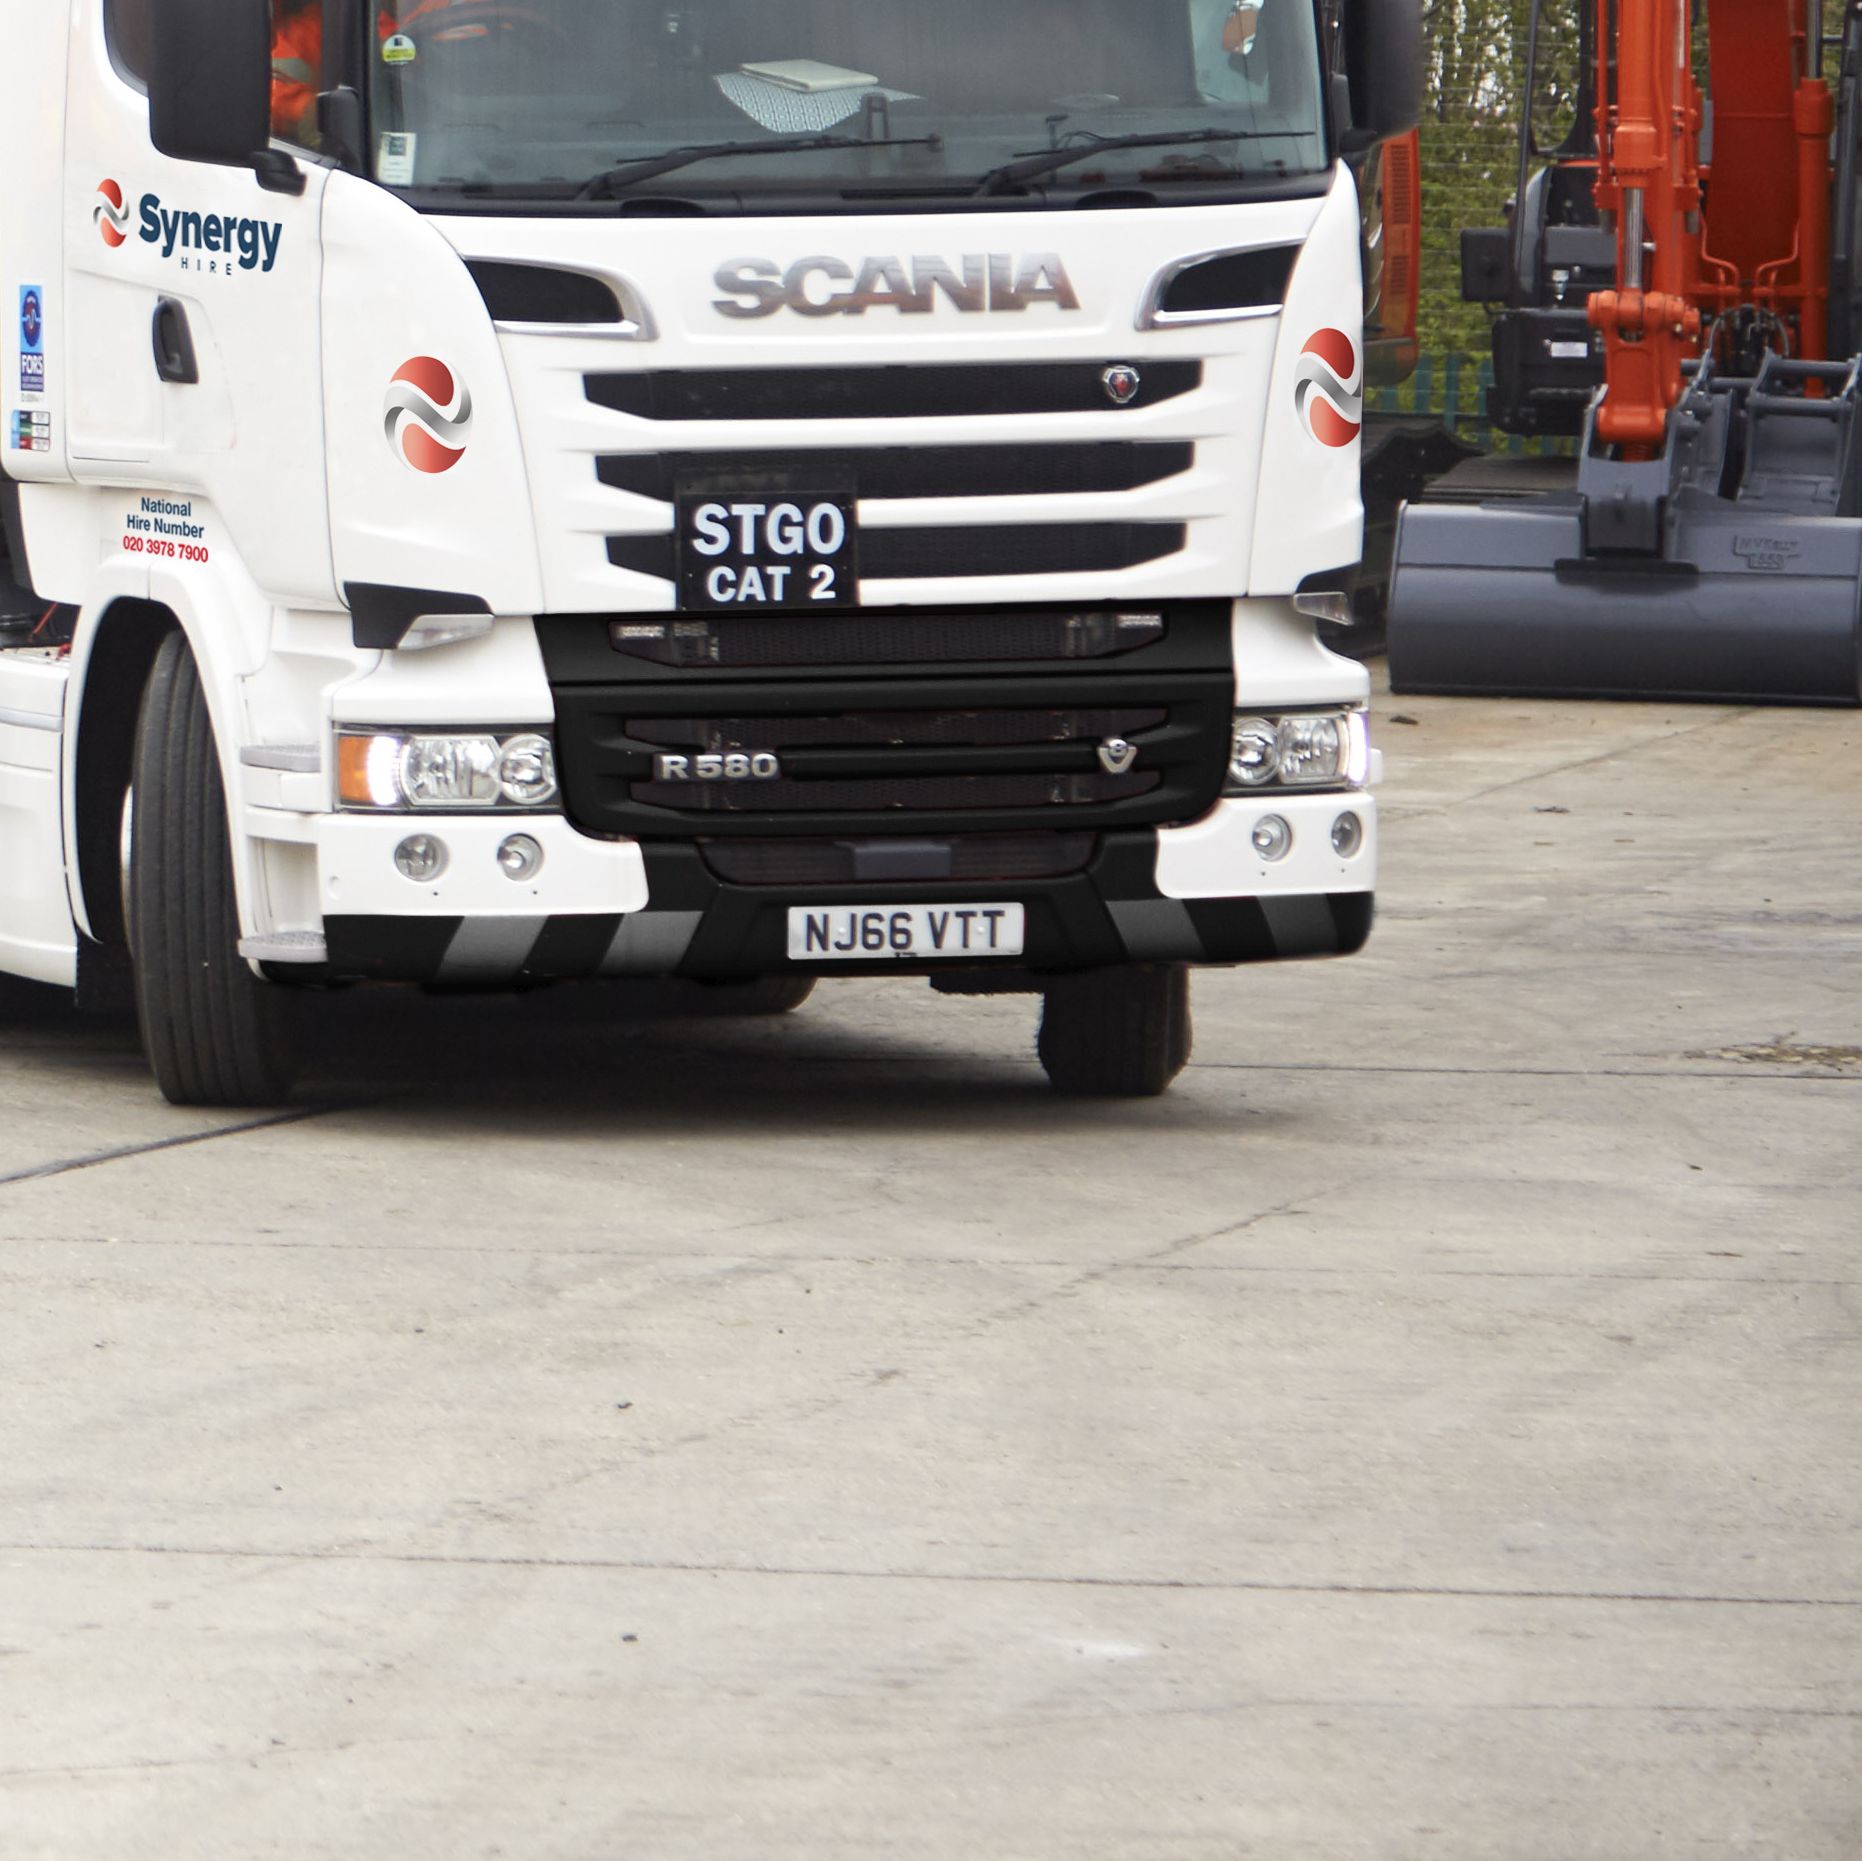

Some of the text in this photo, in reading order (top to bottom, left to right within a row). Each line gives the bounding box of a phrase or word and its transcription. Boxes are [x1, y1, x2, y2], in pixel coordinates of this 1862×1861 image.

[139, 193, 282, 272] Synergy
[181, 257, 232, 275] HIRE
[711, 253, 1080, 320] SCANIA
[21, 354, 43, 375] FORS
[141, 496, 191, 517] National
[127, 514, 204, 539] Hire Number
[692, 502, 845, 556] STGO
[123, 535, 208, 563] 020 3978 7900
[707, 564, 836, 602] CAT 2
[662, 753, 778, 779] R 580
[806, 910, 1005, 952] NJ66 VTT
